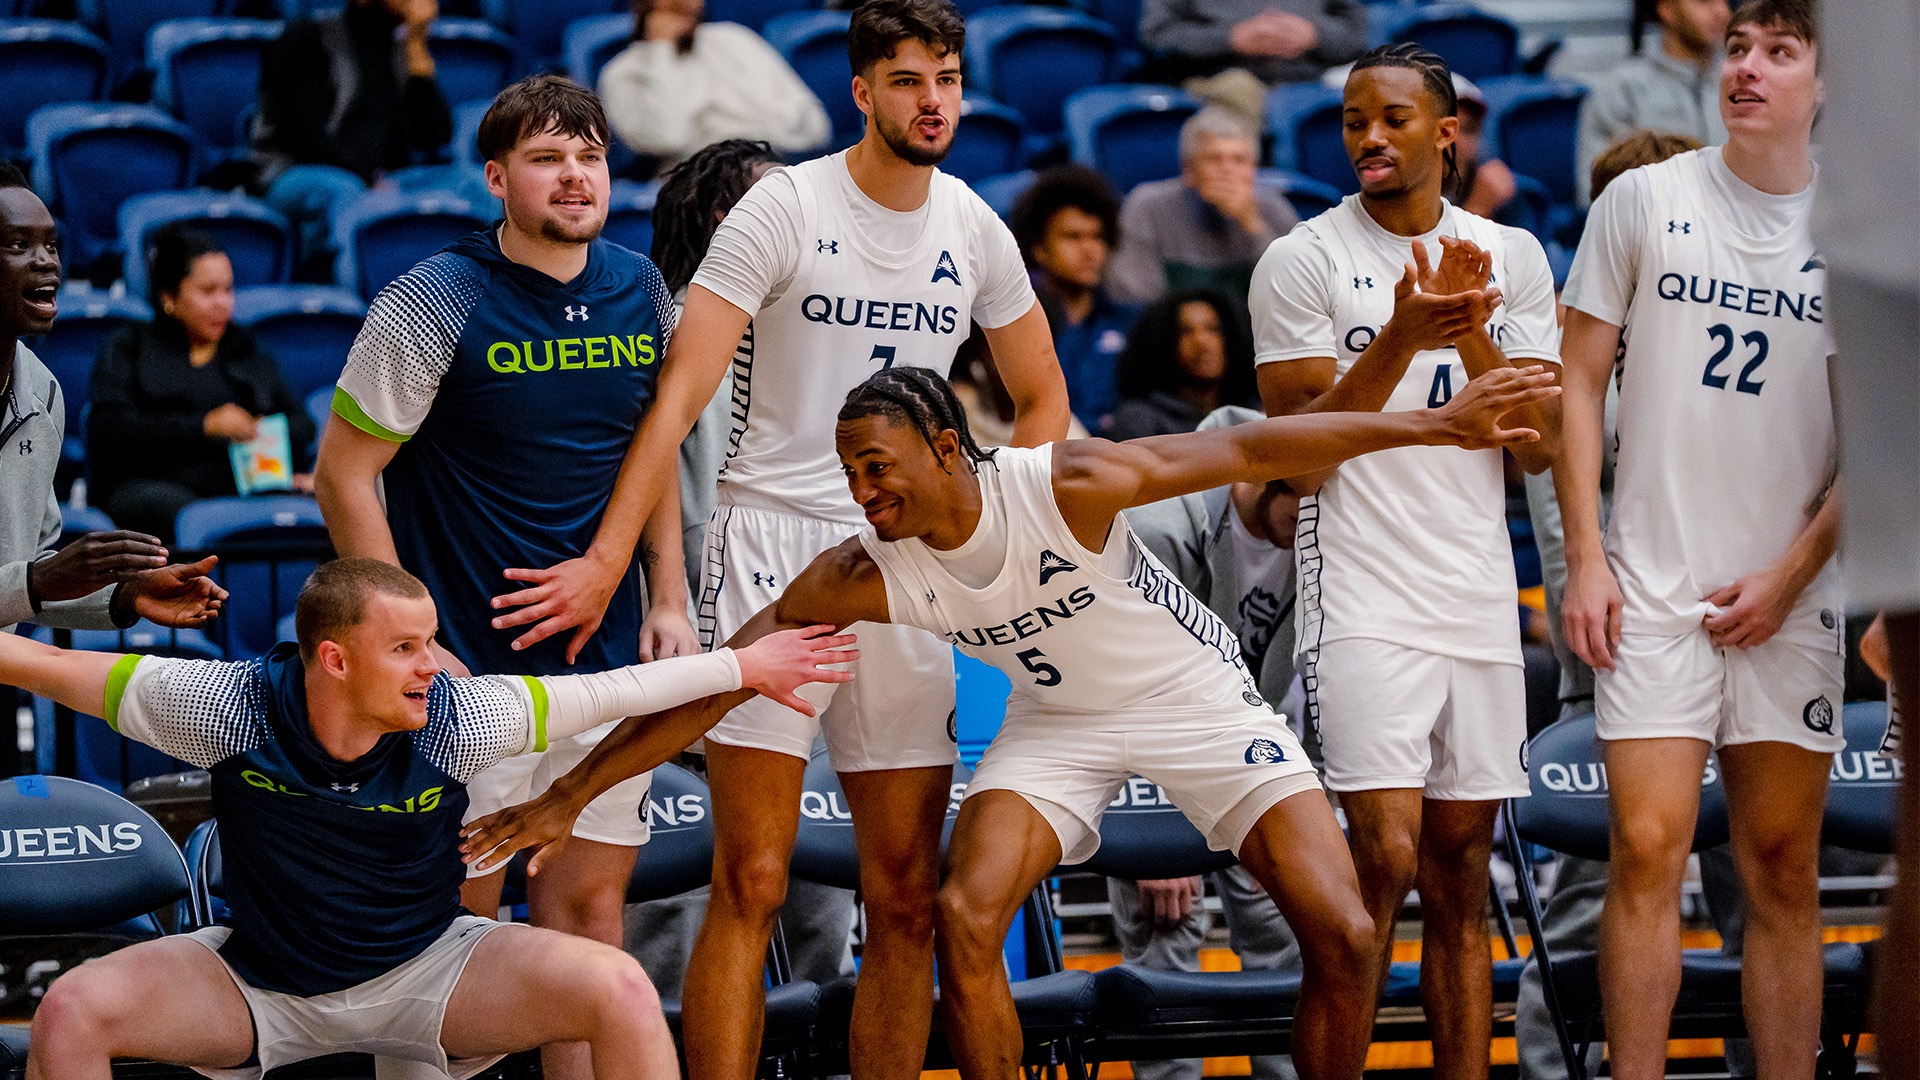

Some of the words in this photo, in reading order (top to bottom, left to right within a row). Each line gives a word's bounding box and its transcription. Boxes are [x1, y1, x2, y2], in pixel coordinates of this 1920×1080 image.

[801, 294, 959, 335] QUEENS
[1658, 272, 1824, 324] QUEENS
[486, 333, 656, 374] QUEENS
[1701, 323, 1770, 397] 22
[1427, 363, 1453, 409] 4
[1015, 646, 1063, 687] 5
